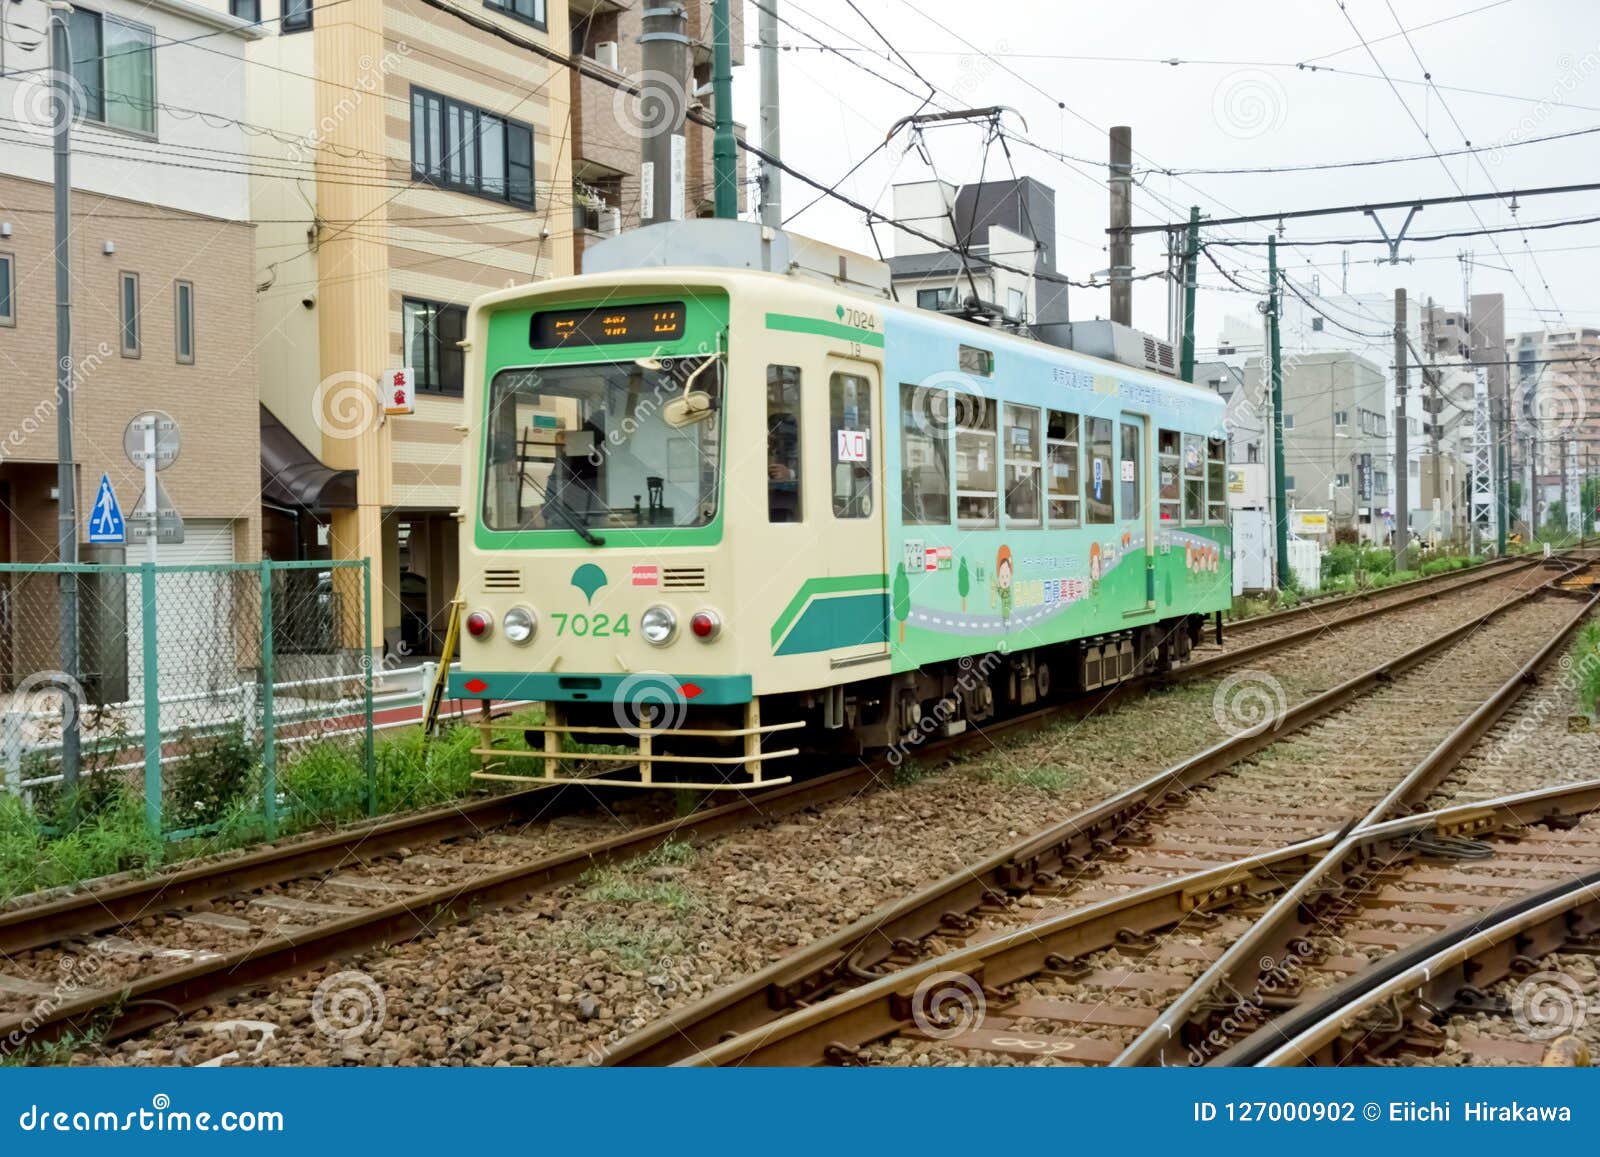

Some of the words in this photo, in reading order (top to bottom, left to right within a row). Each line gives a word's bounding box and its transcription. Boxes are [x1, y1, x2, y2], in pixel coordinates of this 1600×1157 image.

[846, 307, 876, 330] 7024
[840, 433, 866, 458] 入口
[551, 613, 631, 637] 7024
